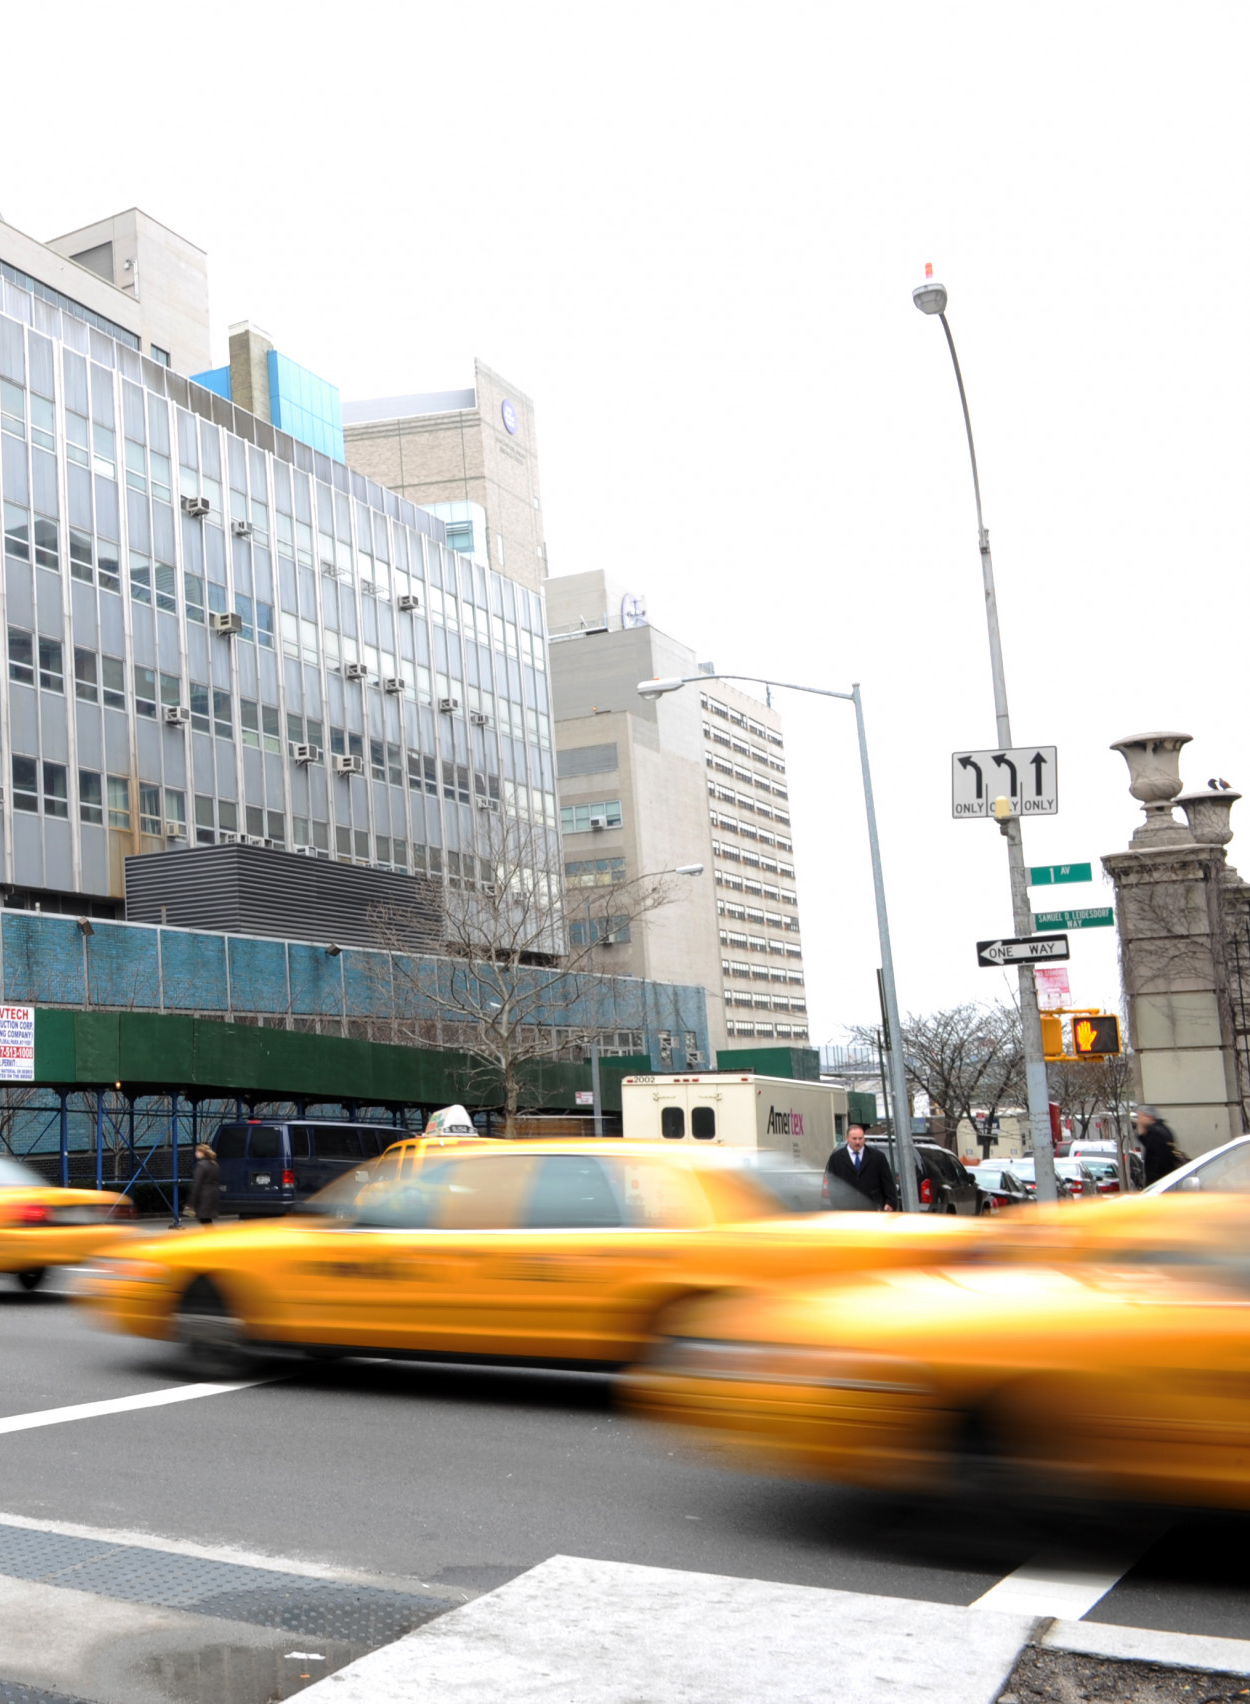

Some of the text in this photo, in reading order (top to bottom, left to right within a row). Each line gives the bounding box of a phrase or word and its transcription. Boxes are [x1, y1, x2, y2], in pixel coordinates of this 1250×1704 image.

[955, 803, 984, 814] ONLY
[990, 801, 1019, 813] OY
[1024, 799, 1054, 811] ONLY
[1049, 866, 1071, 883] 1 AV
[1037, 913, 1062, 923] SAMUEL
[1072, 908, 1110, 920] LEIDESDORF
[1067, 919, 1082, 929] WAY
[989, 943, 1055, 959] ONE WAY
[767, 1105, 804, 1136] Amertex
